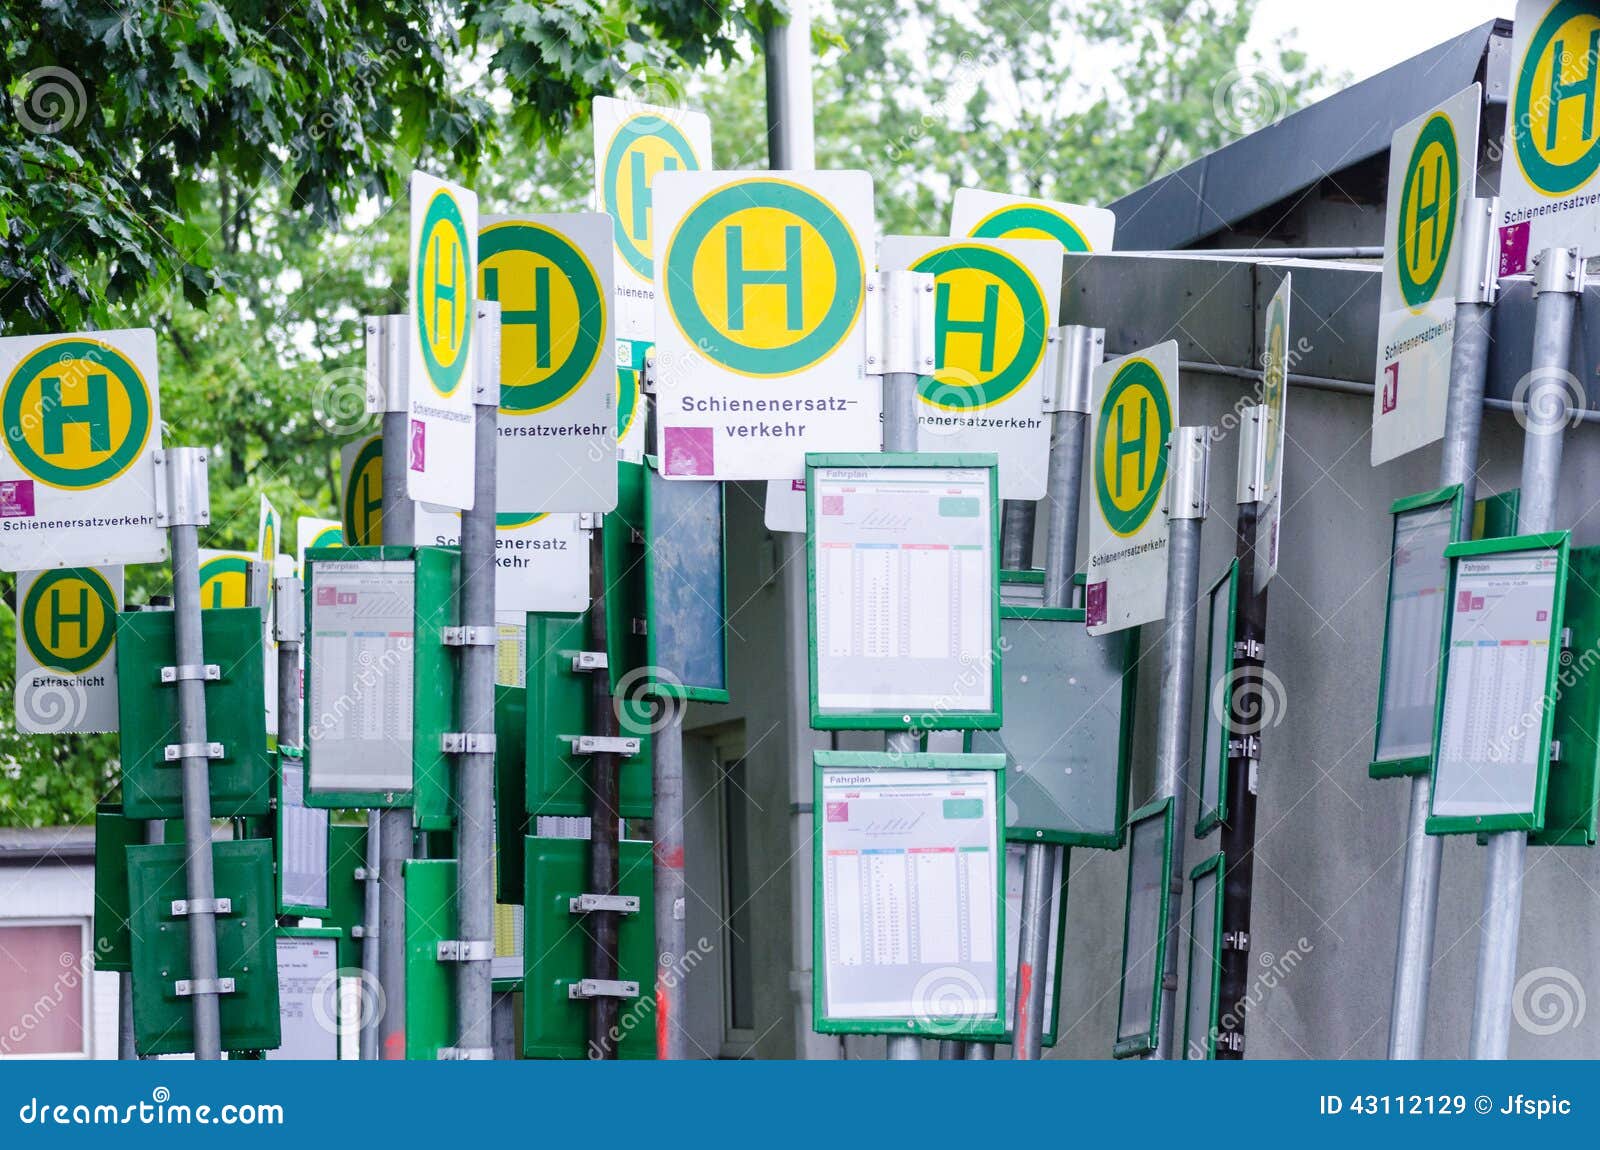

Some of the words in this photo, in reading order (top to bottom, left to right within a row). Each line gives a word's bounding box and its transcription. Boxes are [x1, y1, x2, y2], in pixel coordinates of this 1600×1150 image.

[1546, 28, 1600, 151] H
[1413, 155, 1443, 271] H
[434, 236, 457, 350] H
[484, 267, 551, 369] H
[725, 225, 804, 331] H
[934, 282, 999, 372] H
[40, 374, 111, 455] H
[726, 422, 806, 438] verkehr
[1115, 397, 1148, 499] H
[3, 514, 153, 532] Schienenersatzverkehr
[51, 588, 89, 649] H
[32, 675, 105, 688] Extraschicht
[830, 775, 871, 785] Fahrplan
